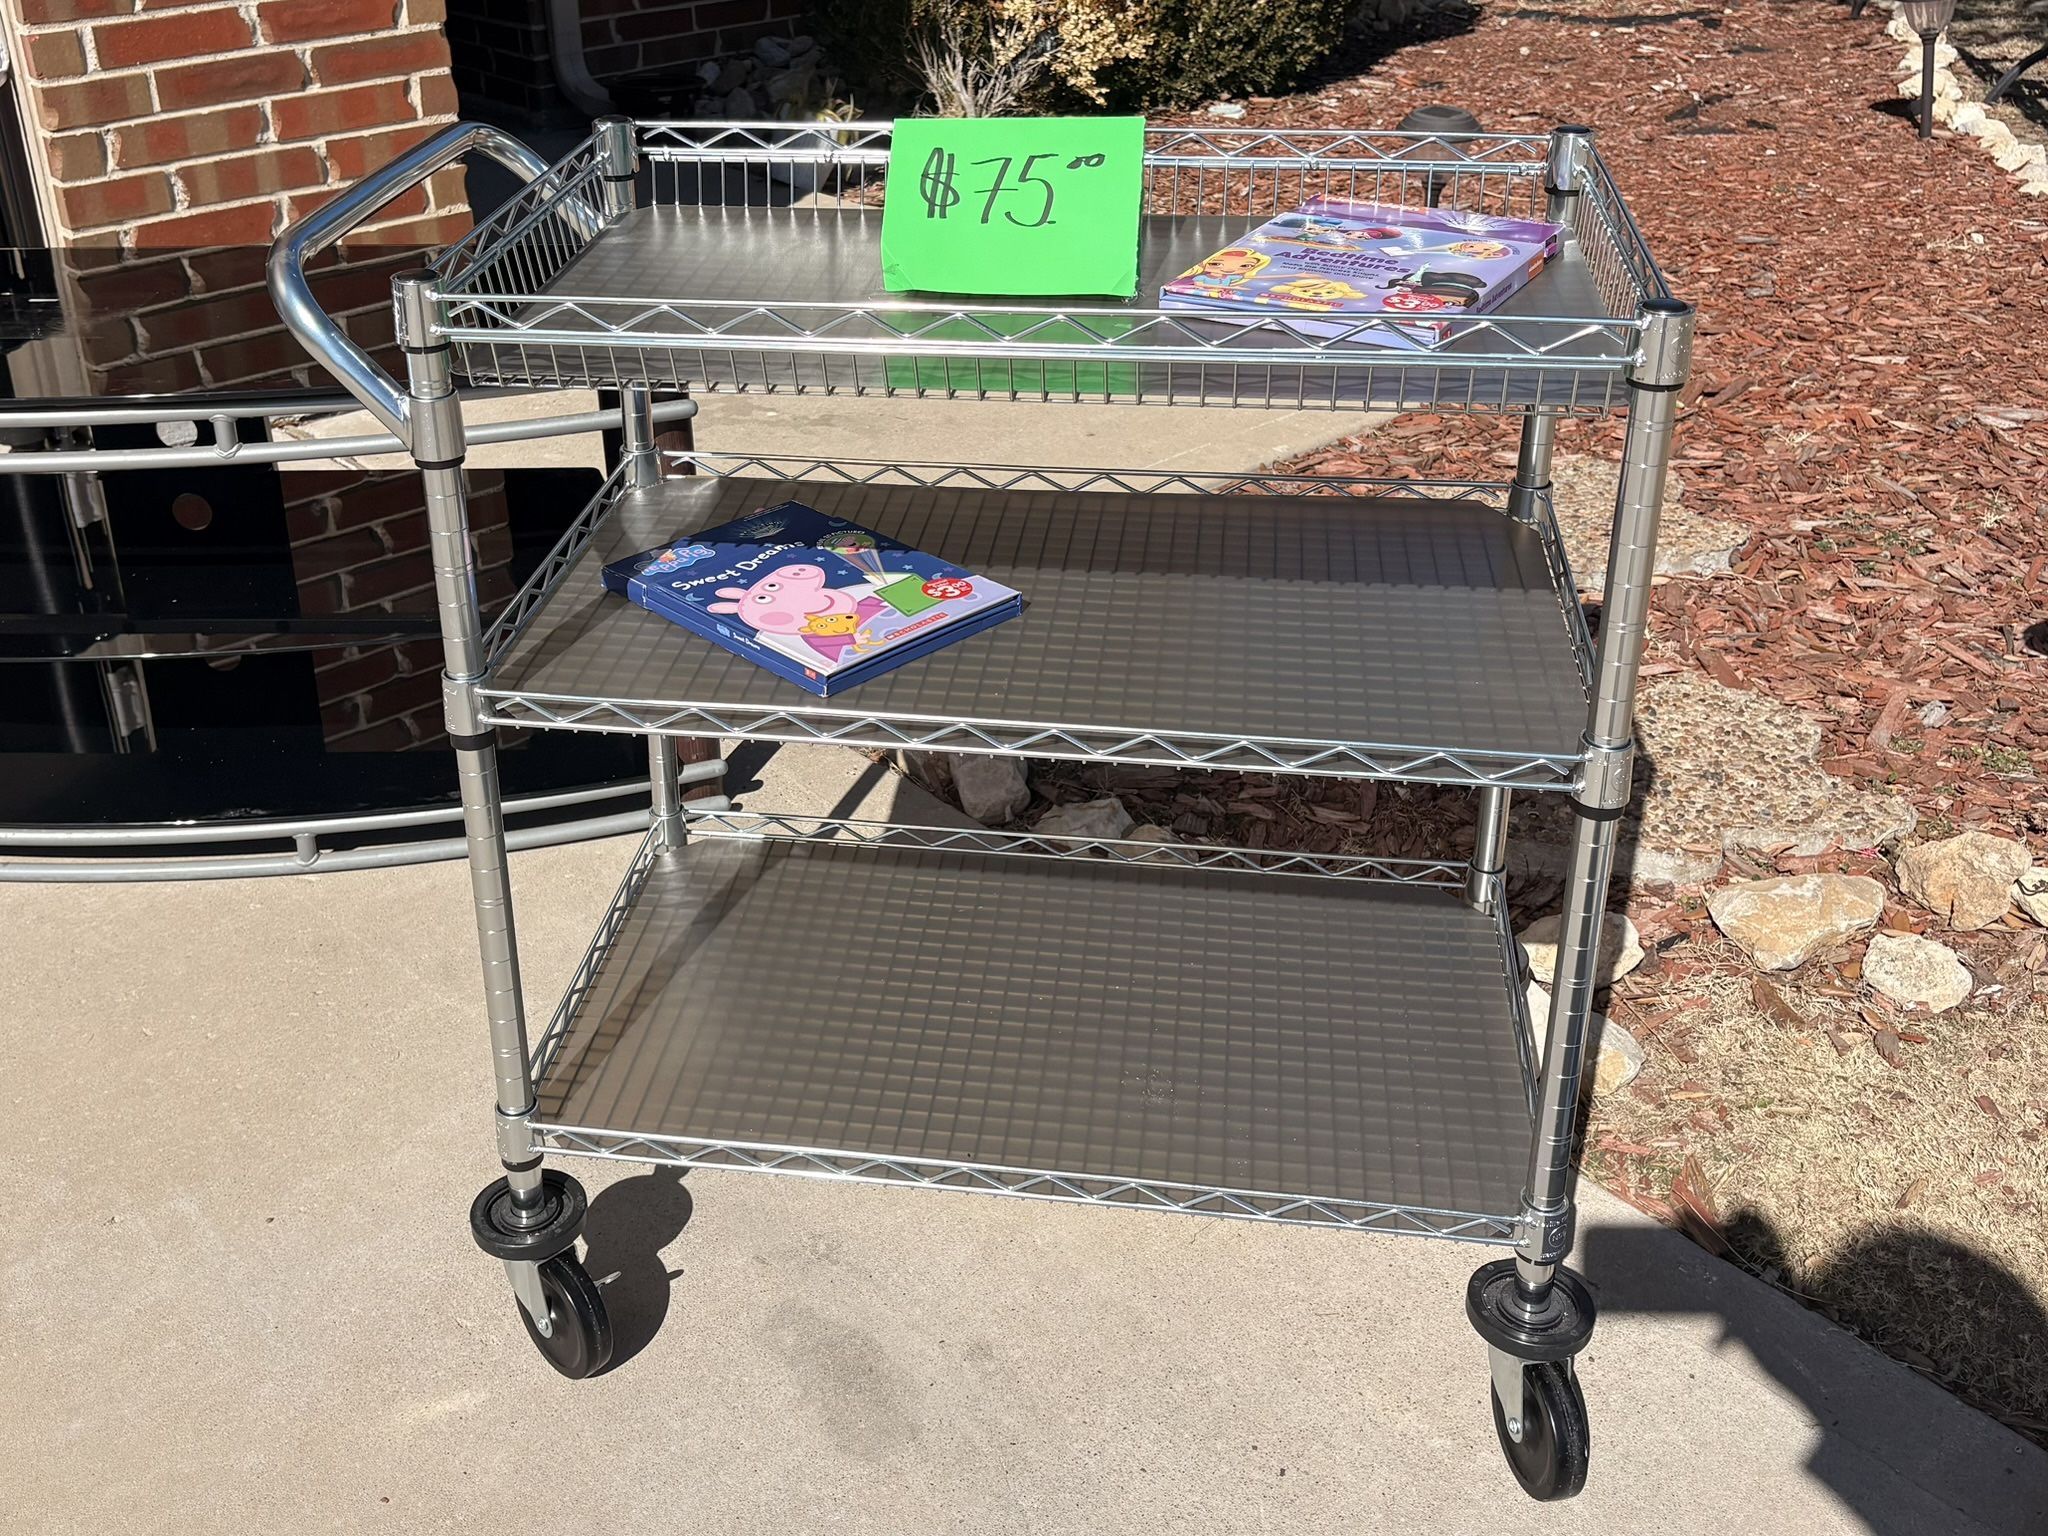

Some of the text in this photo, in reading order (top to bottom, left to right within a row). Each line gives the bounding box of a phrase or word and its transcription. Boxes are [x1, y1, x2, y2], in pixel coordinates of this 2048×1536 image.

[1273, 251, 1412, 274] Adventures
[1300, 247, 1399, 266] Bedtime
[679, 548, 711, 559] Pig
[671, 569, 742, 591] Sweet
[735, 541, 806, 571] Dreams
